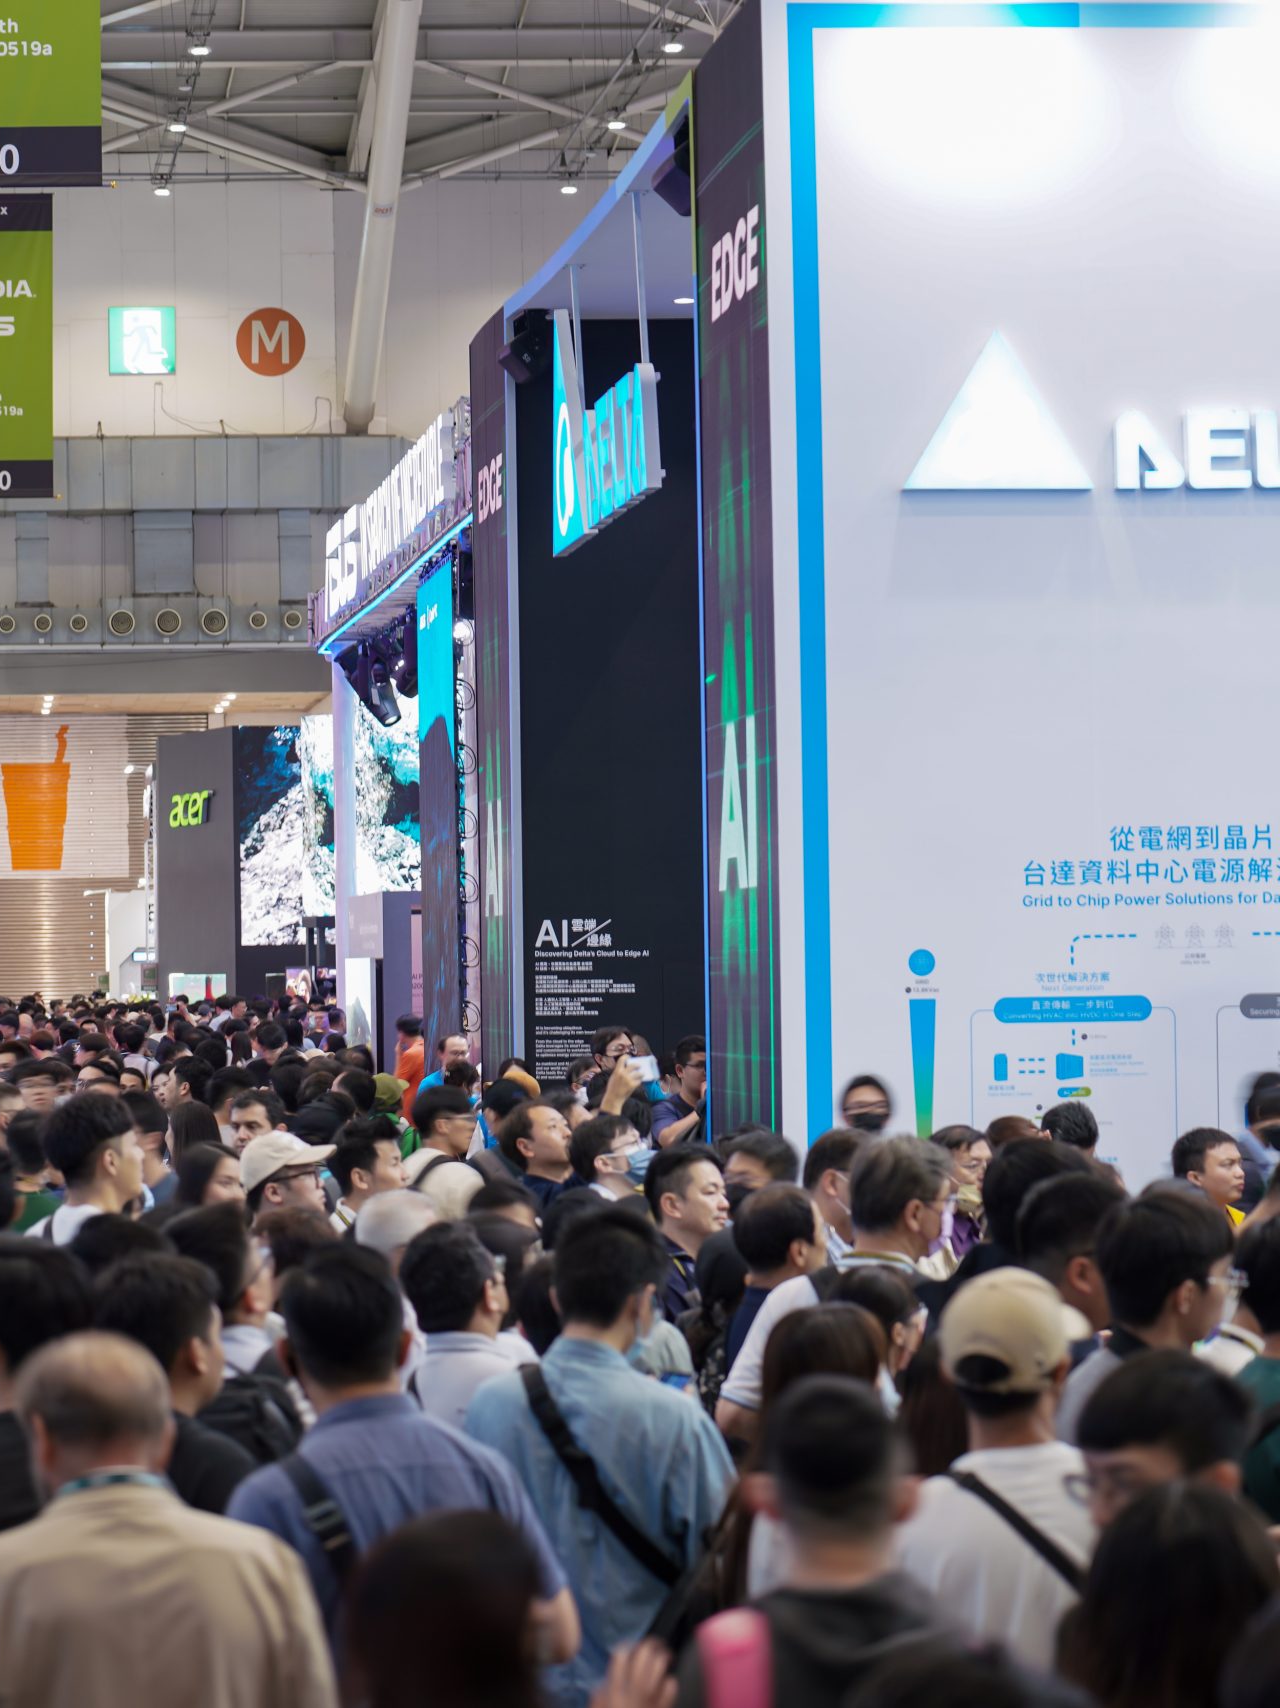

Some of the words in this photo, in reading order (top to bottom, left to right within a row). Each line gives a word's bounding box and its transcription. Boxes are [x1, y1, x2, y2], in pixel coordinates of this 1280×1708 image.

[711, 204, 759, 323] EDGE
[251, 319, 289, 364] M
[1115, 409, 1280, 489] DEL
[478, 452, 503, 524] EDGE
[169, 789, 211, 829] acer
[719, 715, 757, 892] AI
[484, 799, 503, 917] AI
[1110, 824, 1272, 851] 從電網到晶片
[1023, 857, 1280, 886] 台達資料中心電源解
[1022, 894, 1053, 908] Grid
[1058, 895, 1072, 907] to
[1077, 893, 1110, 909] Chip
[1115, 893, 1160, 906] Power
[1165, 891, 1233, 905] Solutions
[1238, 891, 1257, 905] for
[1263, 891, 1280, 904] Da
[535, 919, 568, 948] AI
[535, 950, 572, 959] Discovering
[624, 950, 641, 958] Edge
